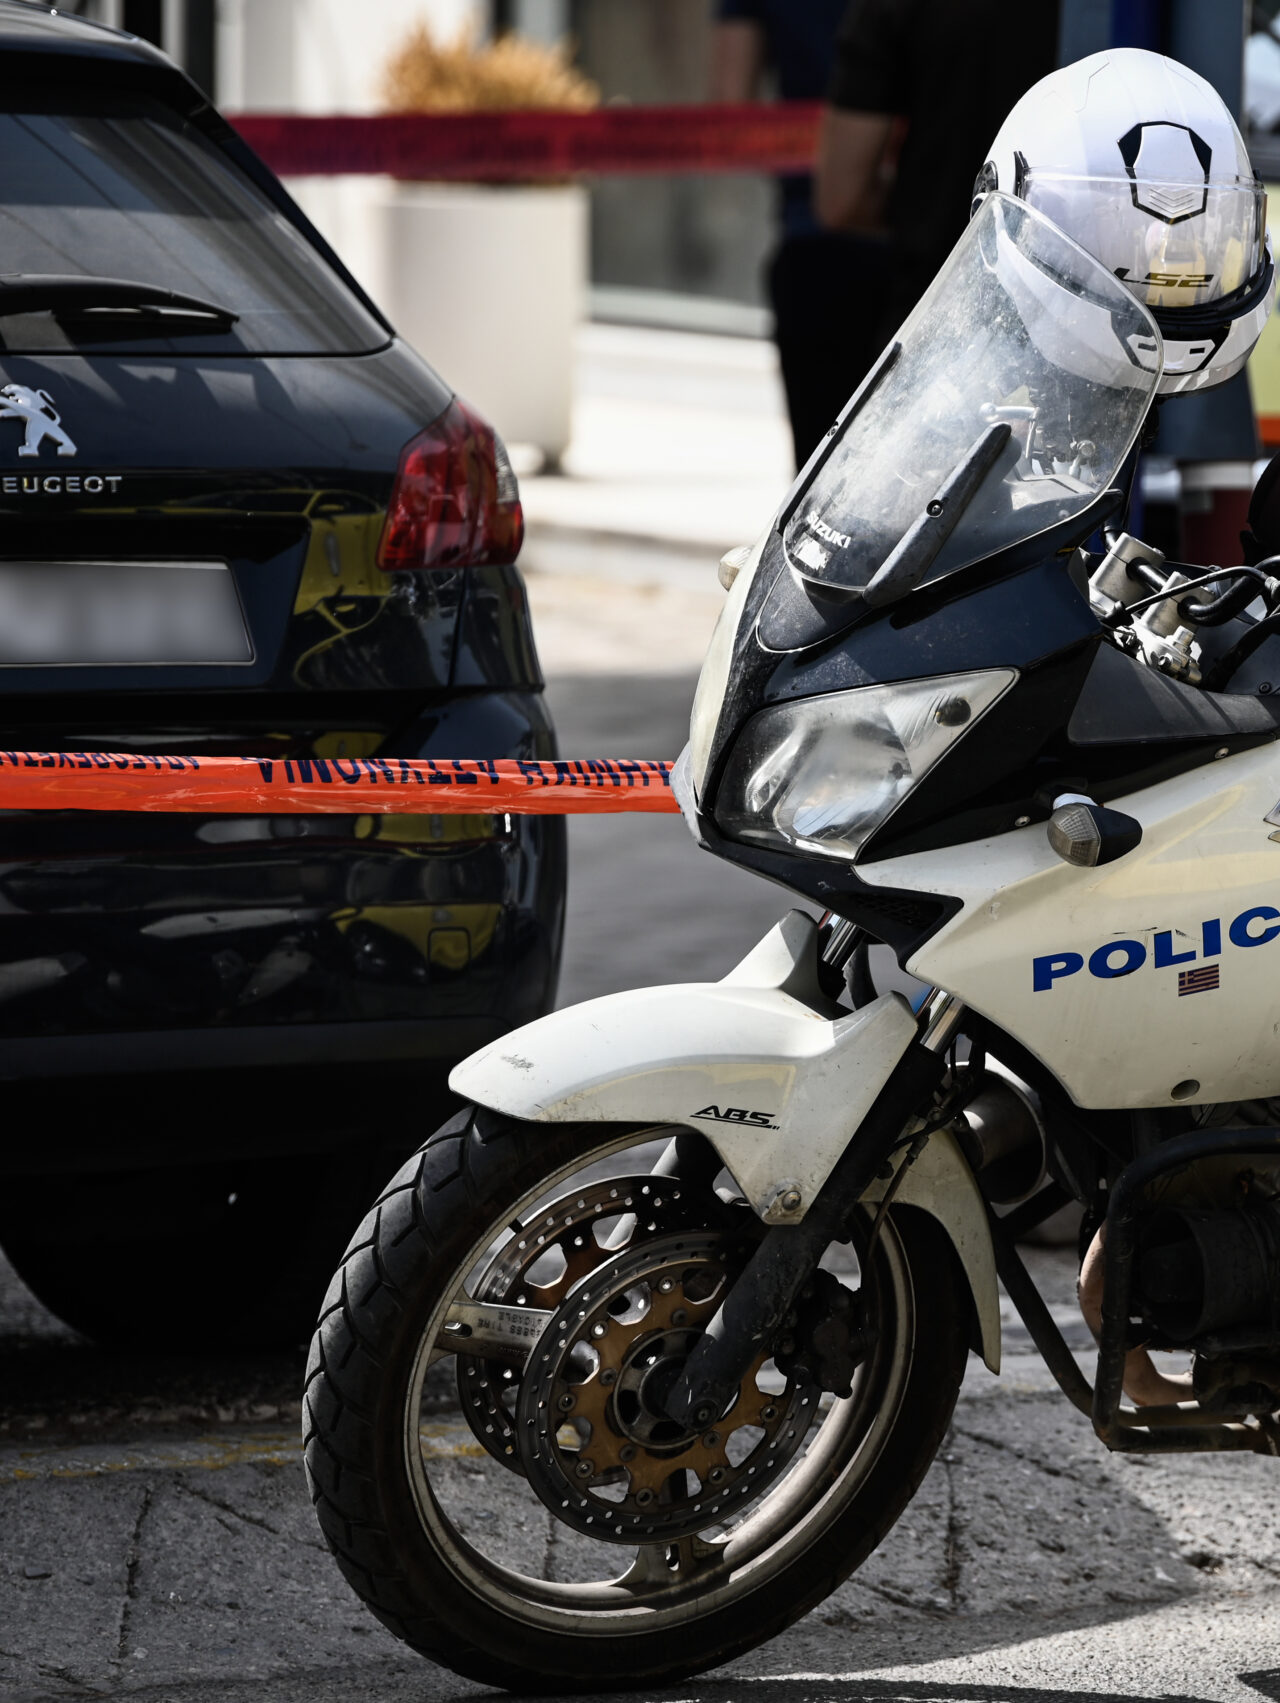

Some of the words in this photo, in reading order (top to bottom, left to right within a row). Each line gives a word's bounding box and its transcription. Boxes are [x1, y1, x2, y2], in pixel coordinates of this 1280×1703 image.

[1113, 267, 1214, 288] LS2
[1, 475, 123, 494] EUGEOT
[806, 510, 852, 549] SUZUKI
[694, 1105, 776, 1125] ABS
